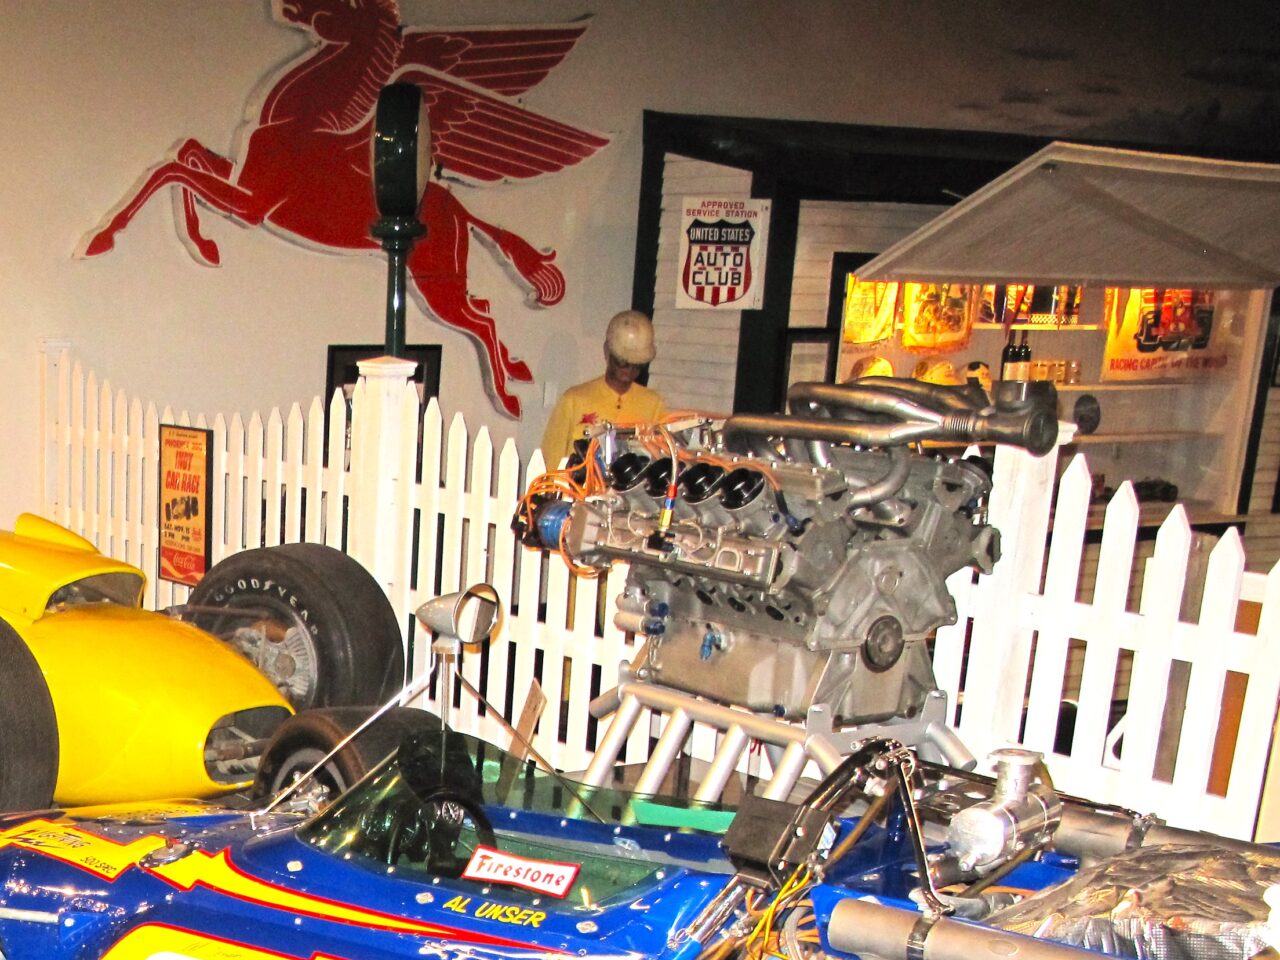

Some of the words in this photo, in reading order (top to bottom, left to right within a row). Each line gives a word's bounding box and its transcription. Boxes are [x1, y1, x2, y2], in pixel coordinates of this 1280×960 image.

[686, 208, 720, 217] SERVICE
[725, 209, 758, 218] STATION
[700, 201, 745, 210] APPROVED
[690, 227, 719, 241] UNITED
[721, 228, 750, 242] STATES
[693, 251, 744, 267] AUTO
[692, 271, 742, 286] CLUB
[181, 472, 201, 494] RACE
[475, 854, 567, 887] Firestone
[442, 895, 469, 913] AL
[474, 902, 547, 928] UNSER
